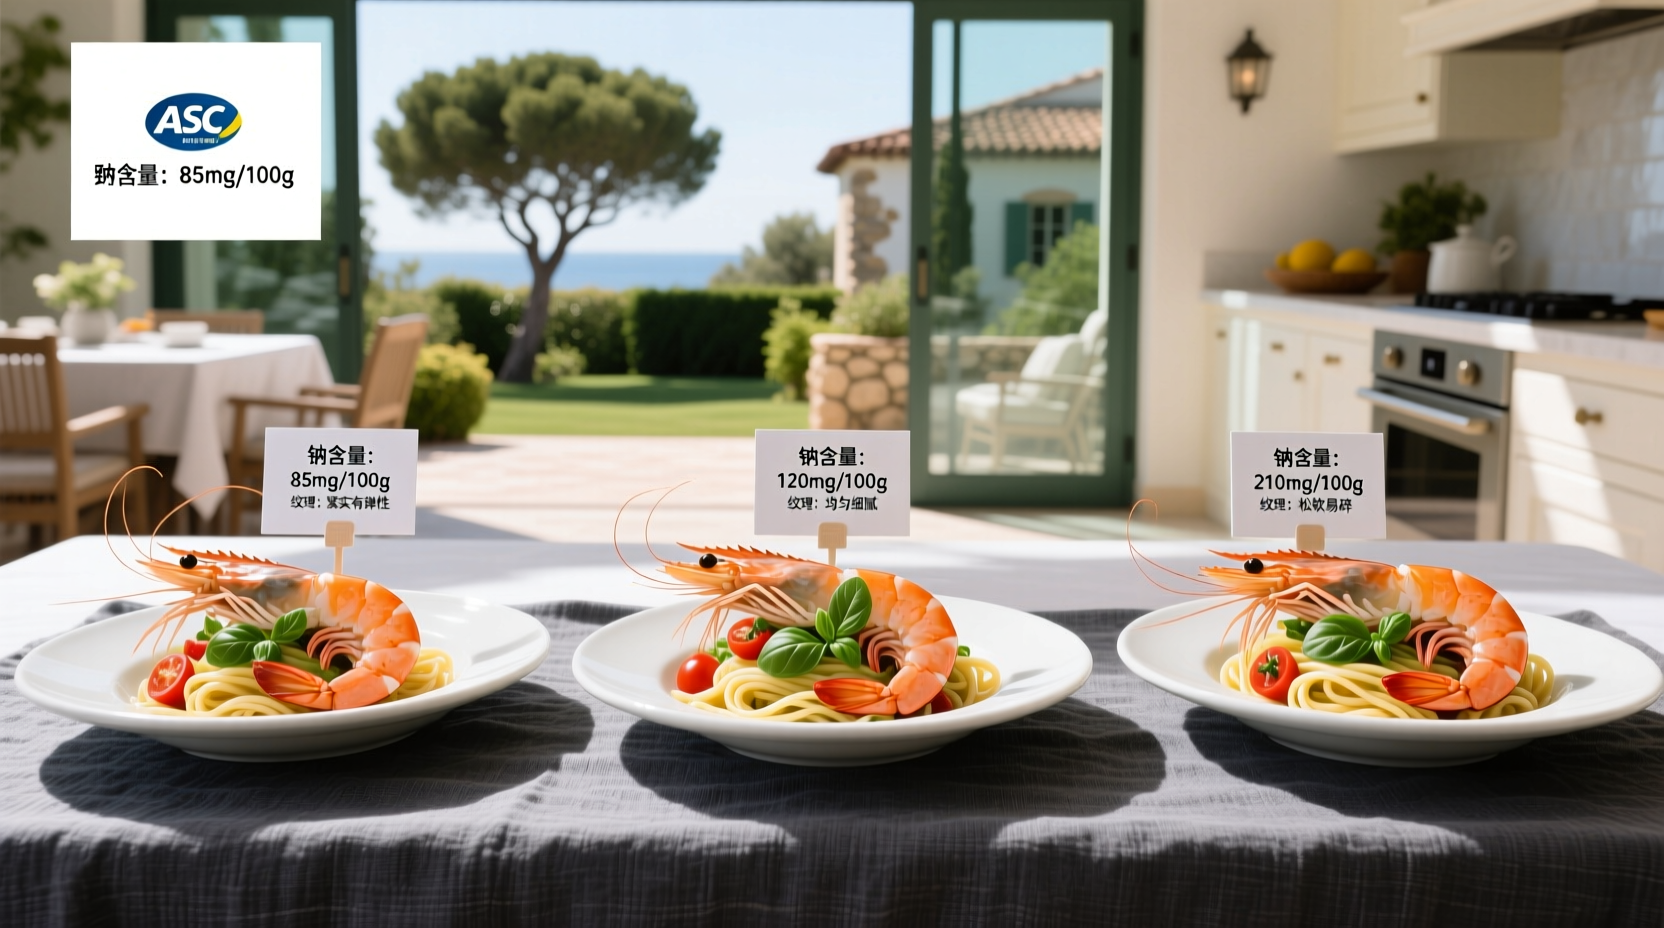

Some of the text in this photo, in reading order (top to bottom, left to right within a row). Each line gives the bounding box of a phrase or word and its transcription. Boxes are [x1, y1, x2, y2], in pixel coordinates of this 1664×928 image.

[307, 444, 373, 466] 钠含量：
[798, 446, 864, 467] 钠含量：
[1273, 447, 1339, 468] 钠含量：
[290, 471, 391, 493] 85mg/100g
[777, 472, 888, 494] 120mg/100g
[1253, 473, 1364, 496] 210mg/100g
